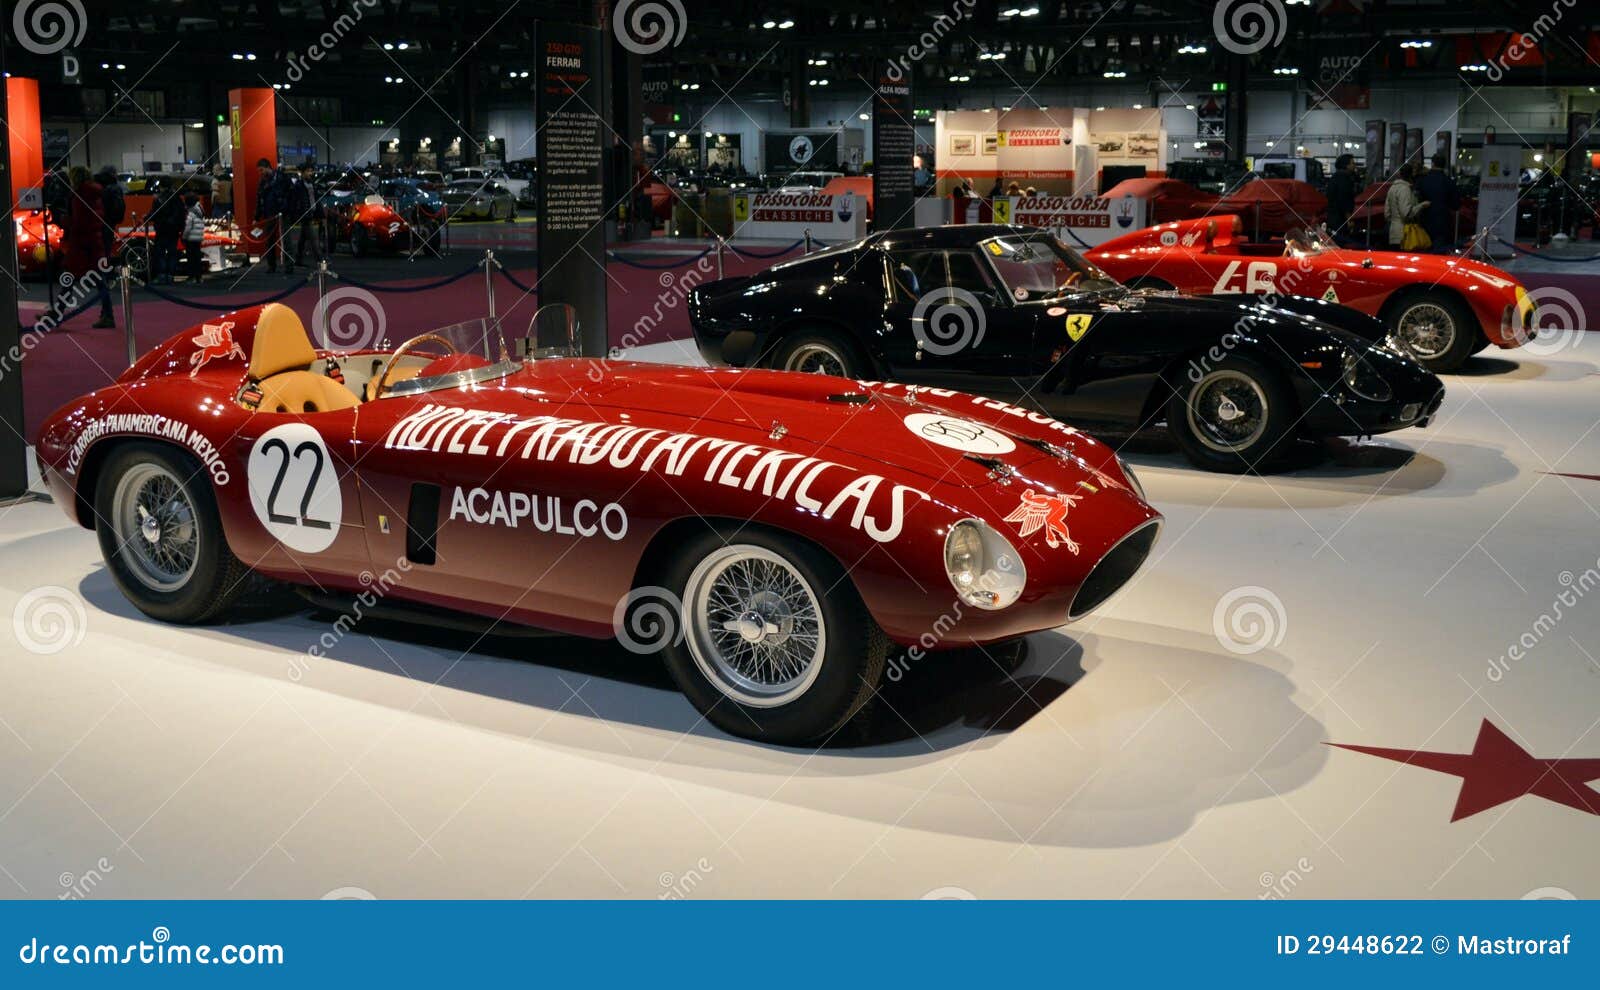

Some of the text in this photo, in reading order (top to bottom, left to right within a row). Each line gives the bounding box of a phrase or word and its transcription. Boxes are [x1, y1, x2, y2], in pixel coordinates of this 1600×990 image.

[564, 43, 581, 55] GTO
[64, 56, 78, 76] D
[546, 56, 581, 68] FERRARI
[1320, 56, 1360, 69] AUTO
[642, 81, 669, 92] AUTO
[880, 85, 893, 94] ALFA
[1009, 129, 1060, 137] ROSSOCORSA
[1027, 171, 1067, 179] Department
[753, 194, 833, 207] ROSSOCORSA
[1015, 197, 1111, 211] ROSSOCORSA
[754, 210, 831, 221] CLASSICHE
[1017, 214, 1109, 226] CLASSICHE
[388, 221, 401, 235] 2
[70, 418, 106, 466] CARRERA
[106, 413, 188, 443] PANAMERICANA
[187, 430, 230, 486] MEXICO
[385, 404, 931, 543] HOTEL PRADO AMERICAS
[261, 438, 331, 530] 22
[450, 486, 628, 541] ACAPULCO
